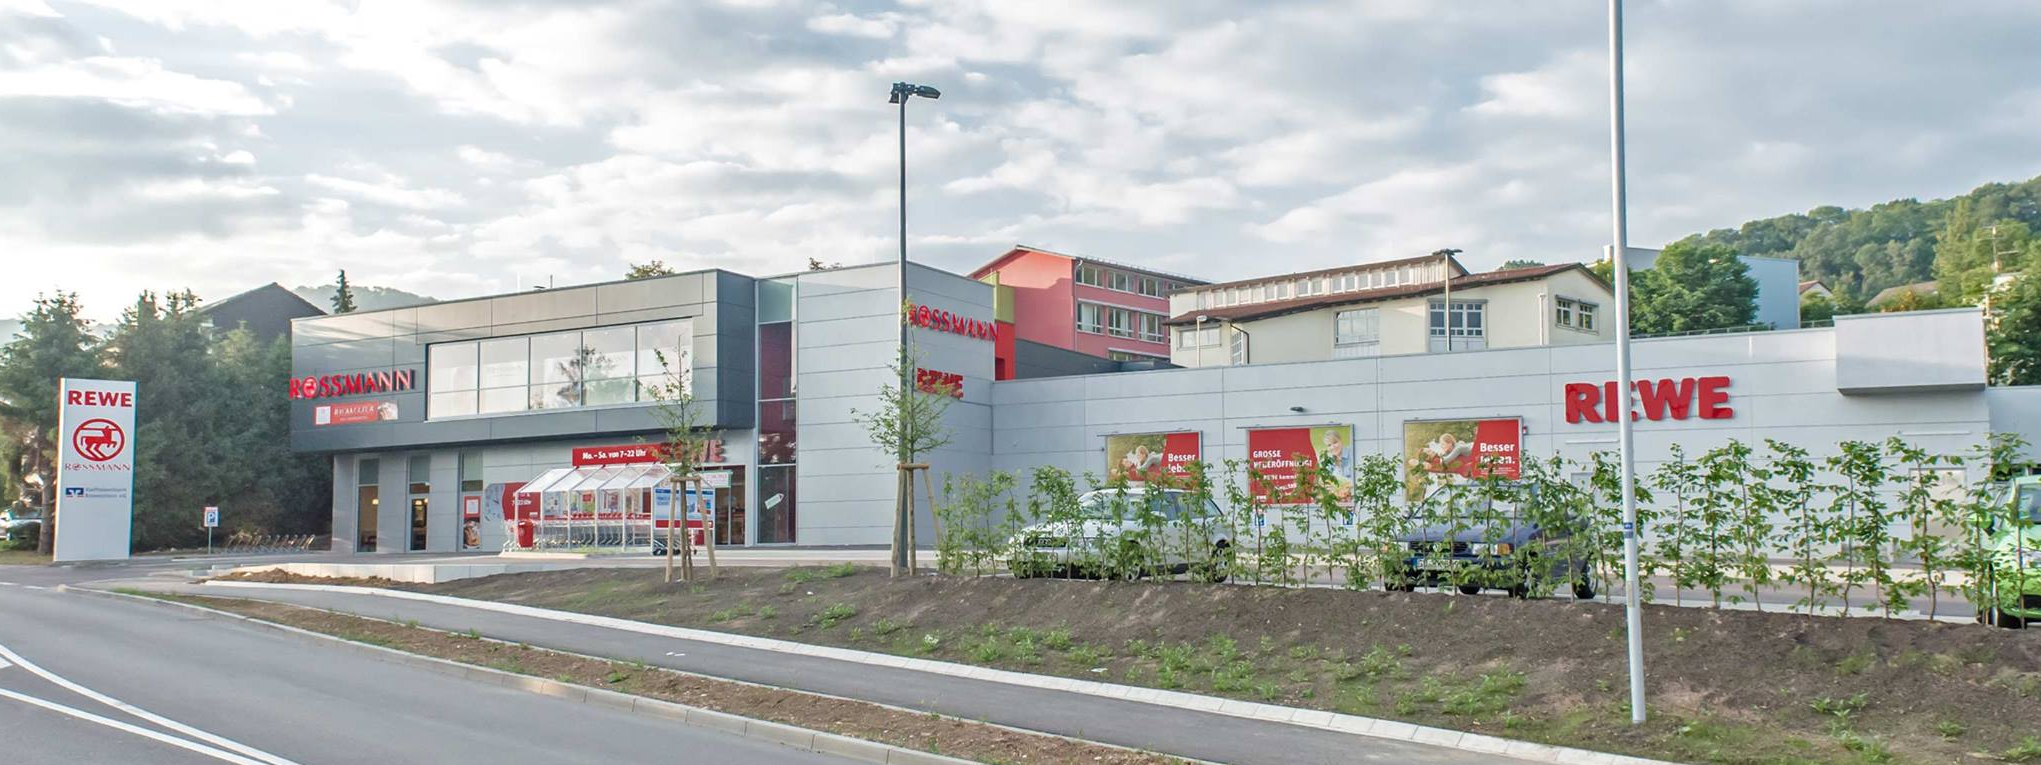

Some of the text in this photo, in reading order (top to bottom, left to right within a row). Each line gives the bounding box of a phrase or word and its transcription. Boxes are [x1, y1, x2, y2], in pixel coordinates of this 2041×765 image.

[289, 368, 416, 400] ROSSMANN
[67, 390, 132, 408] REWE
[1565, 376, 1734, 424] REWE
[1480, 442, 1515, 452] Besser
[1168, 453, 1196, 462] Besser
[1253, 450, 1281, 458] GROSSE
[64, 463, 131, 471] ROSSMANN
